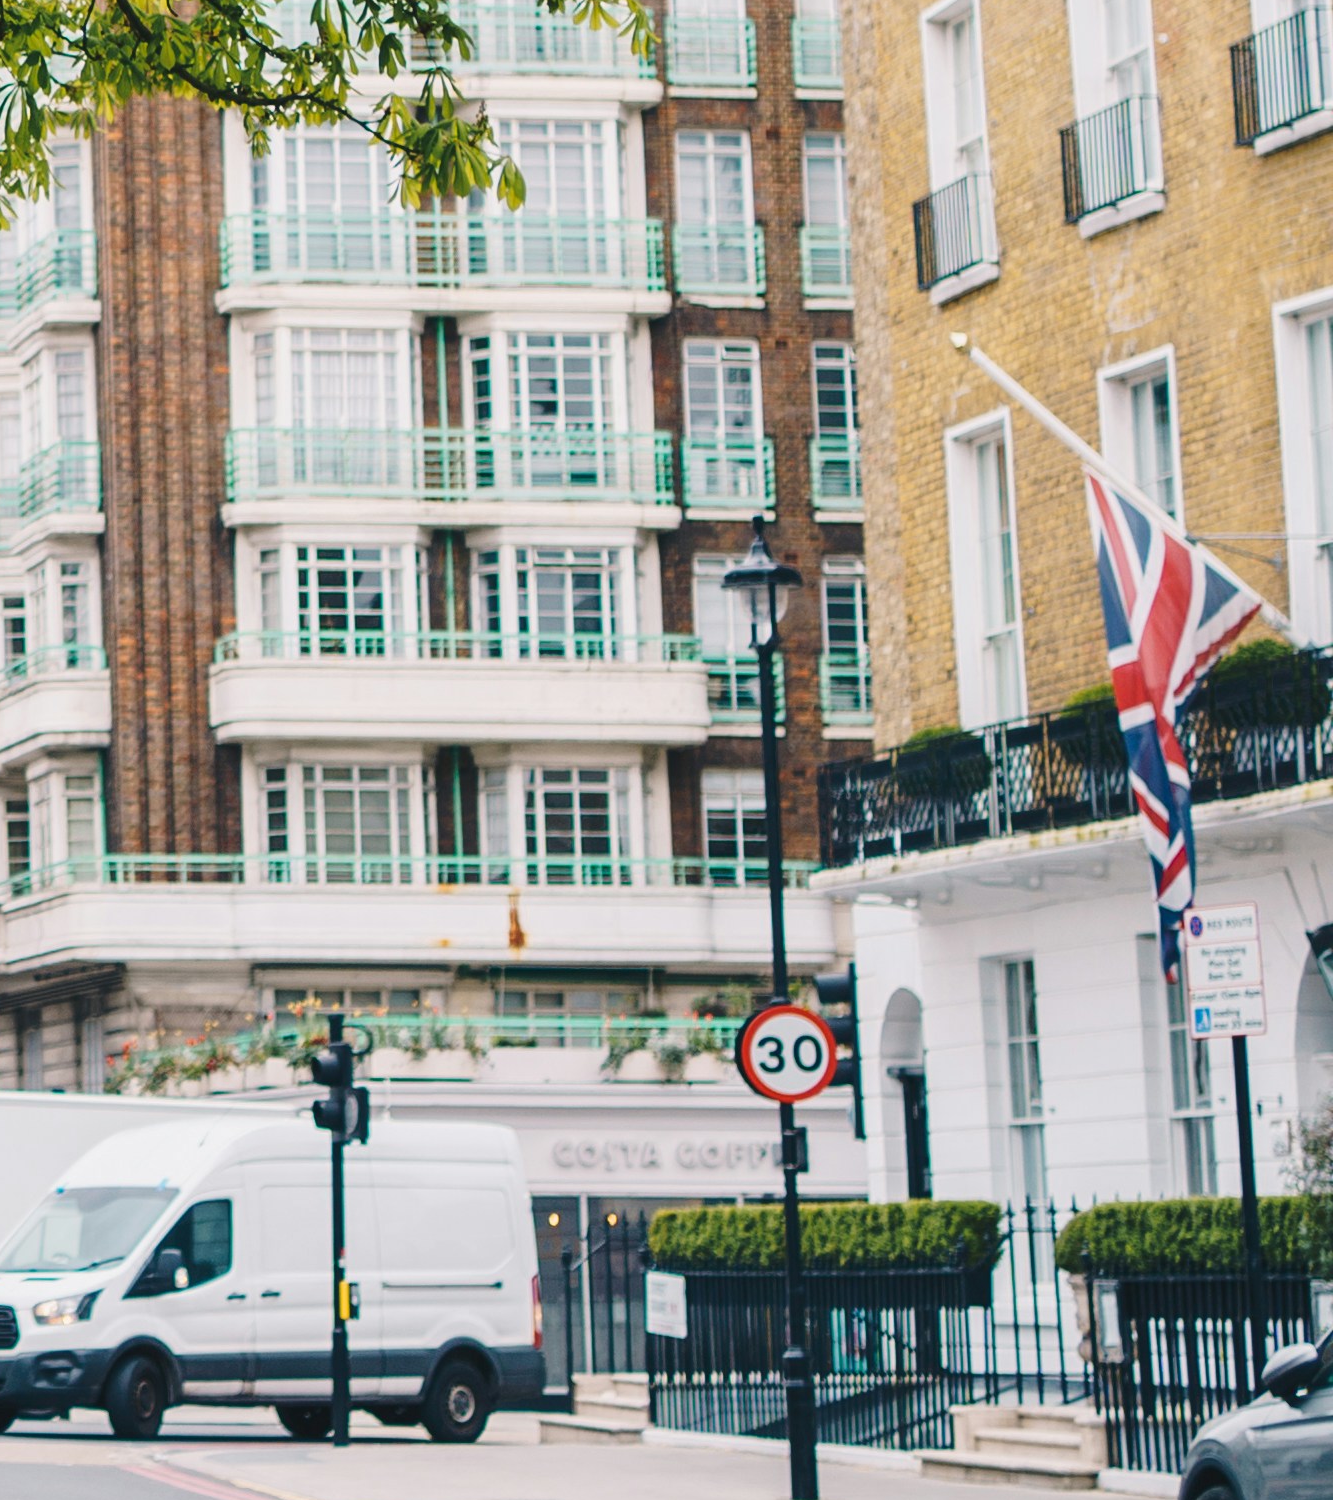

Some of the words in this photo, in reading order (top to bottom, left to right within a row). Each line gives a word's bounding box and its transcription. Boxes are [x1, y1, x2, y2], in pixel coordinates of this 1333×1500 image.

[757, 1034, 824, 1074] 30
[552, 1139, 663, 1172] COSTA
[675, 1139, 784, 1170] COFF
